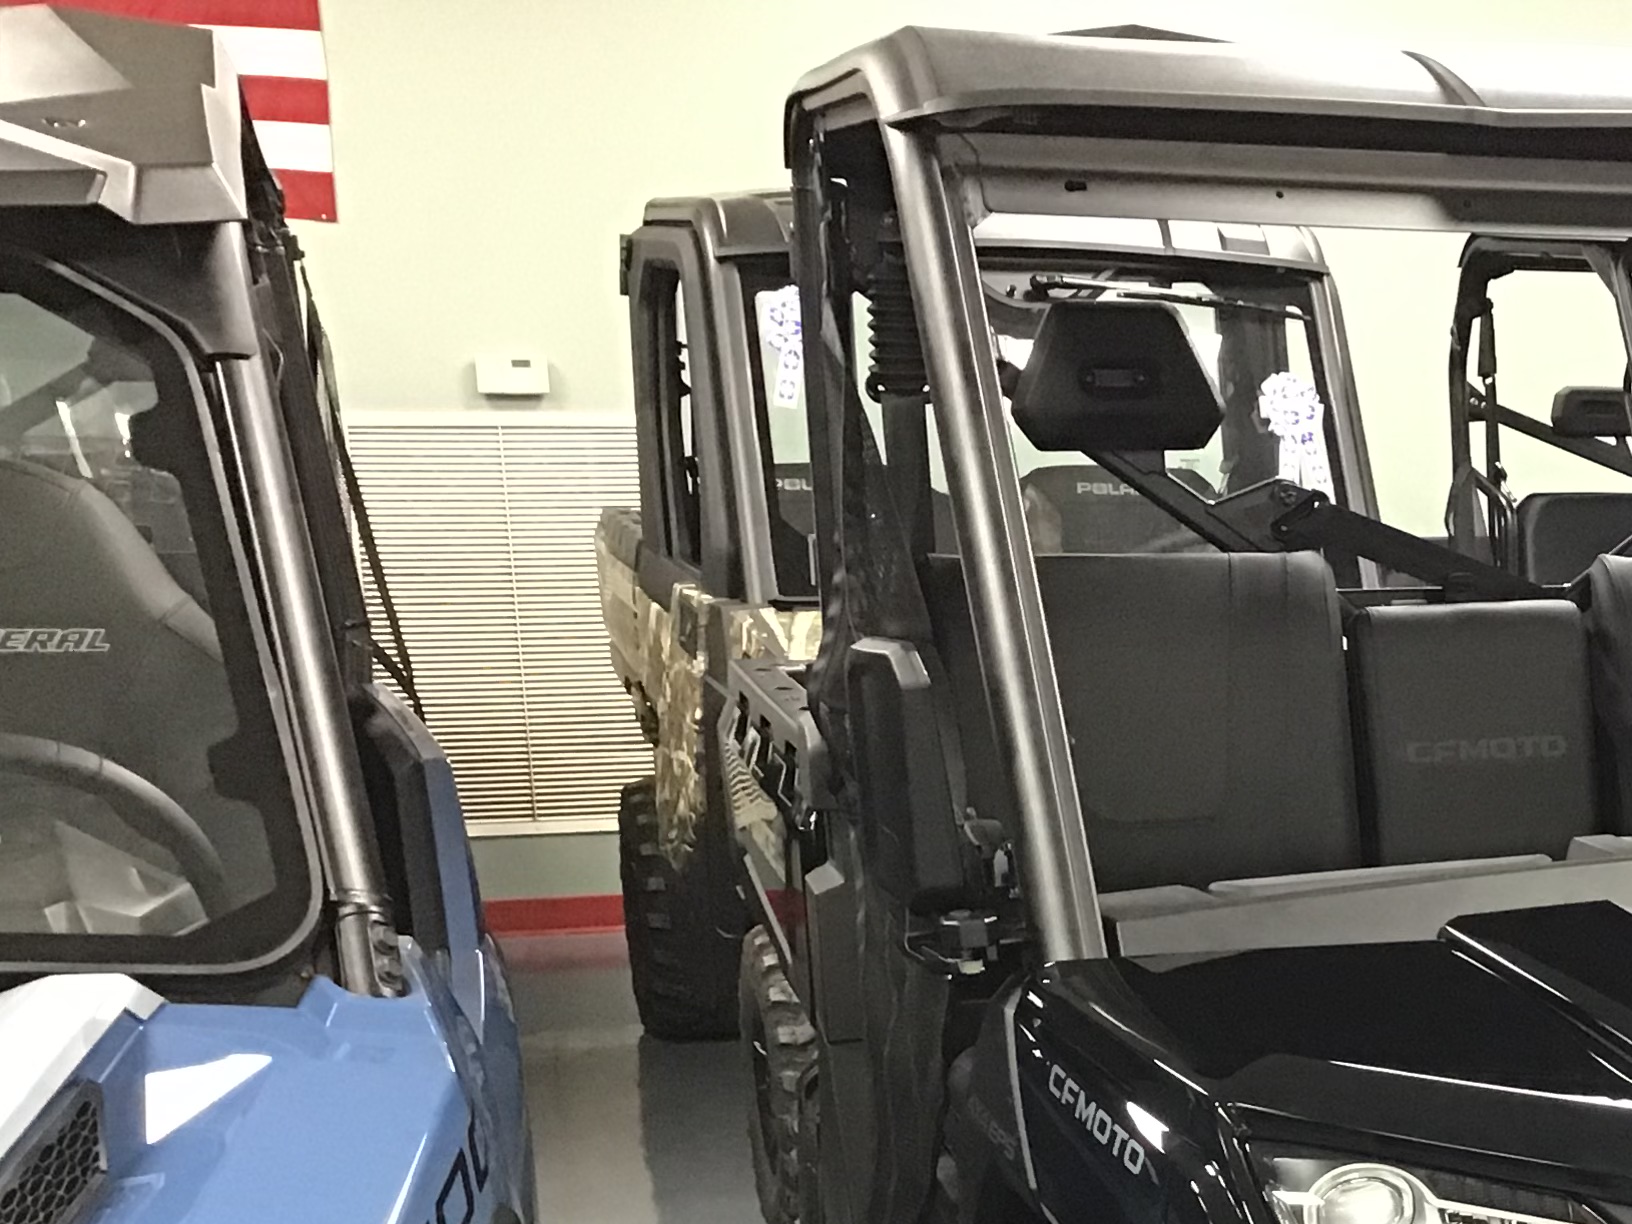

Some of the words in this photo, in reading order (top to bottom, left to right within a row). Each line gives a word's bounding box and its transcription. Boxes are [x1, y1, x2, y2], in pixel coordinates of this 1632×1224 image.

[1076, 481, 1141, 496] POLA
[1406, 734, 1568, 763] CFMOTO
[1047, 1063, 1145, 1176] CFMOTO
